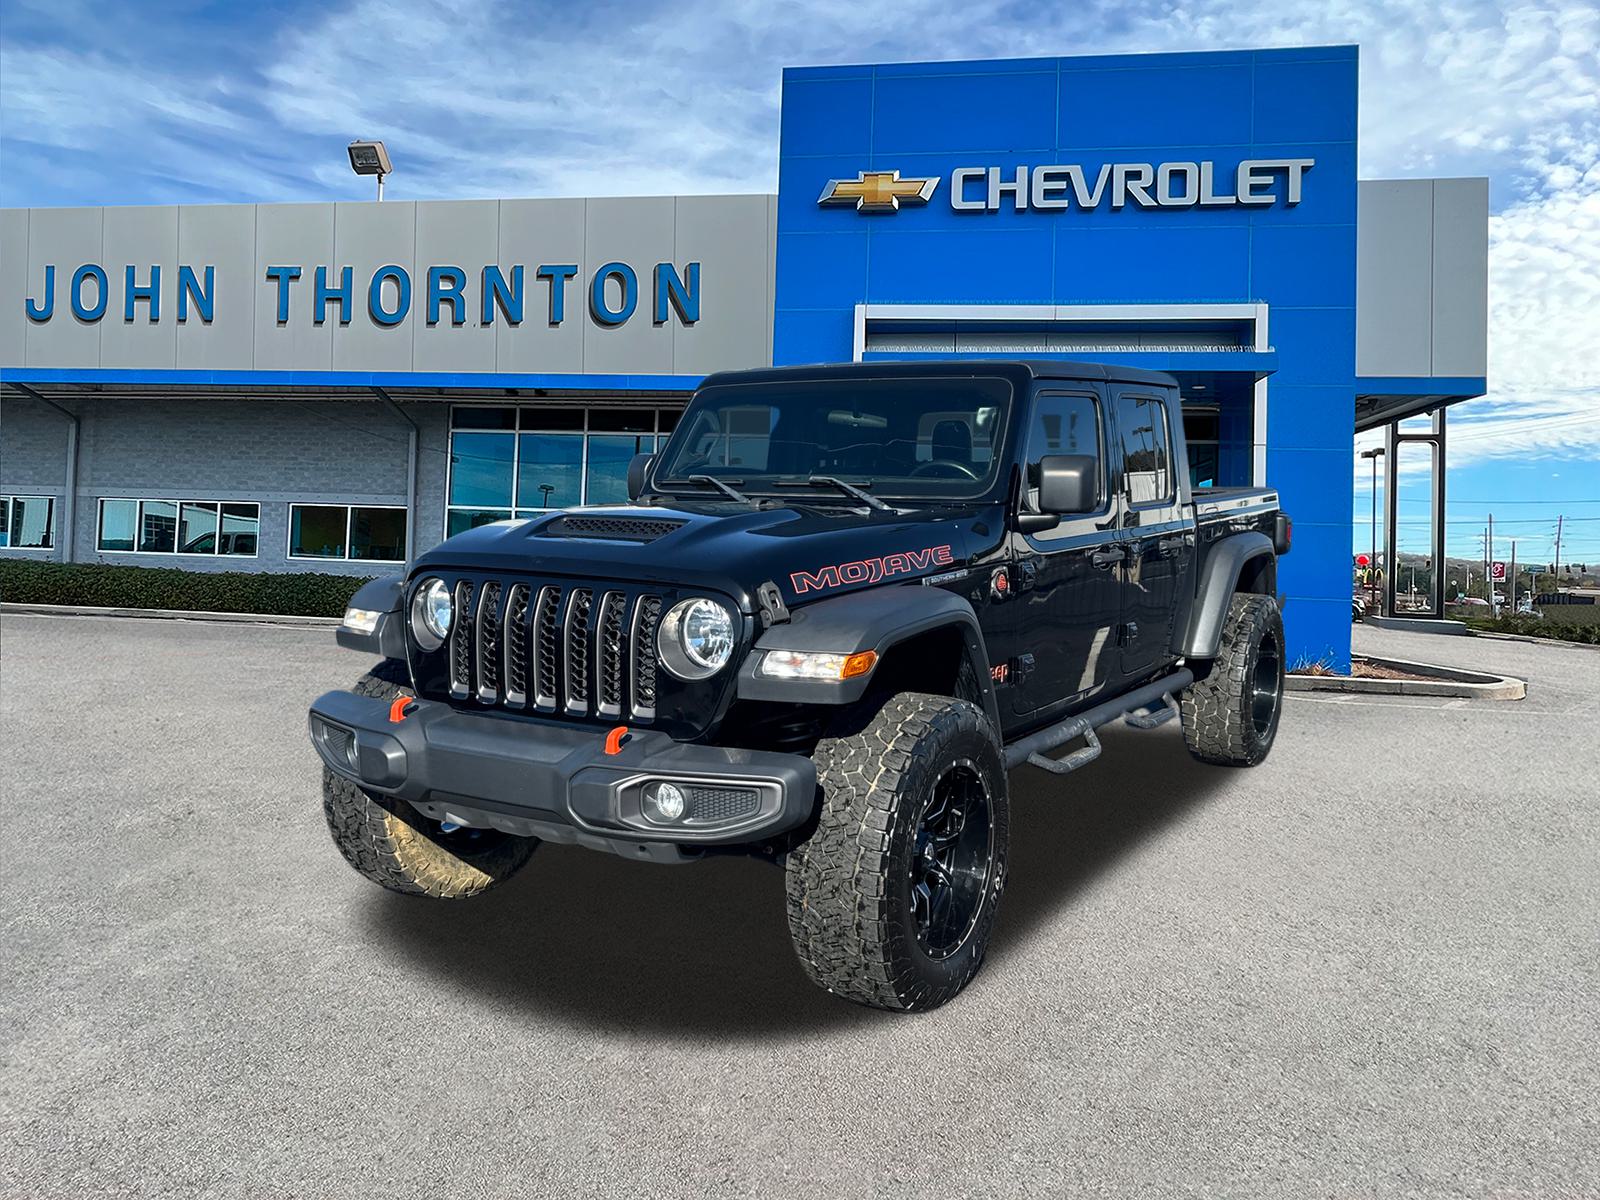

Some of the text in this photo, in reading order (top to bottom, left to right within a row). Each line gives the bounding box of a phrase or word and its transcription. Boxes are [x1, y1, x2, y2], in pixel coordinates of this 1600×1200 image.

[950, 158, 1315, 211] CHEVROLET
[25, 261, 701, 327] JOHN THORNTON
[790, 545, 953, 593] MOJAVE
[990, 664, 1008, 682] eep
